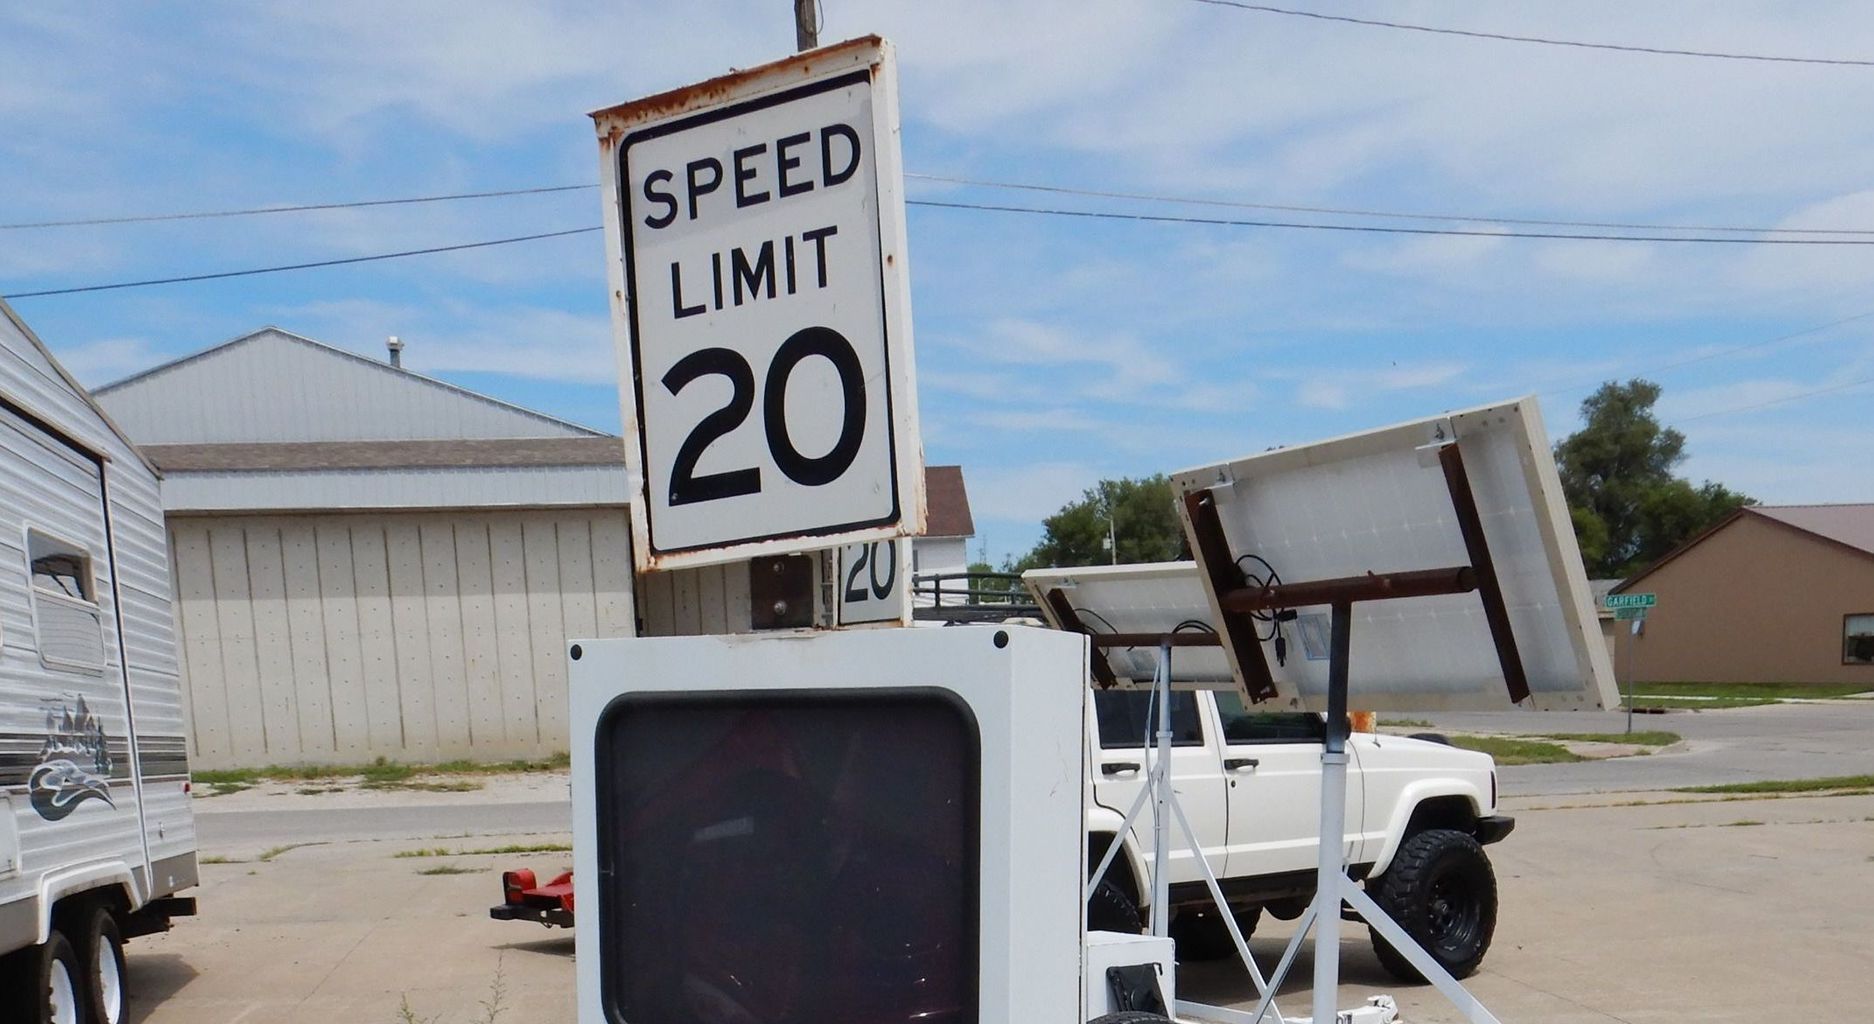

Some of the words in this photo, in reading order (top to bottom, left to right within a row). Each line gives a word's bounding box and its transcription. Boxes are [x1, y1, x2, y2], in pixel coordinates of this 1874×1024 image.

[644, 123, 861, 230] SPEED
[671, 225, 838, 319] LIMIT
[661, 326, 867, 507] 20
[844, 540, 896, 603] 20
[1607, 595, 1647, 608] GARFIELD
